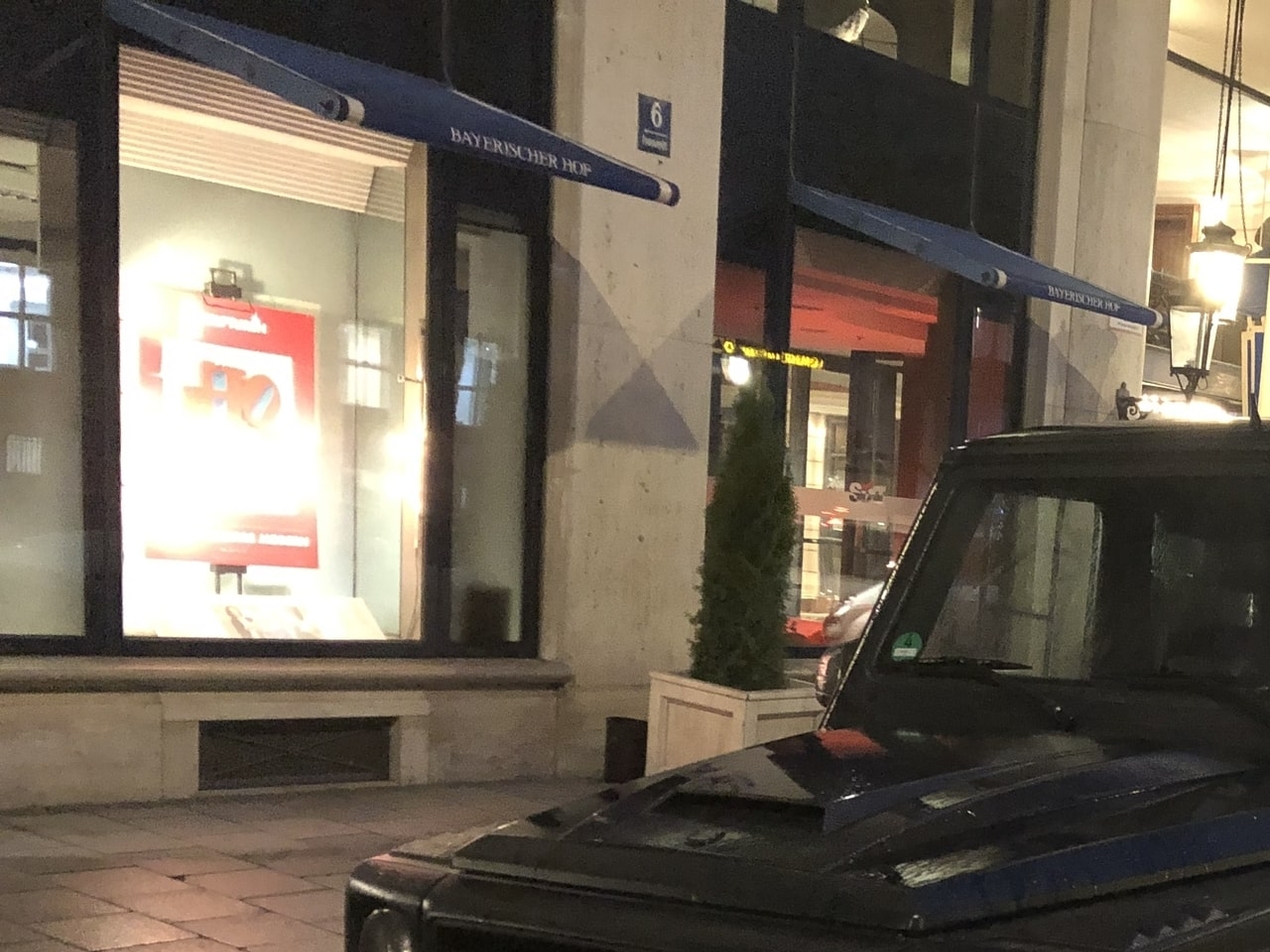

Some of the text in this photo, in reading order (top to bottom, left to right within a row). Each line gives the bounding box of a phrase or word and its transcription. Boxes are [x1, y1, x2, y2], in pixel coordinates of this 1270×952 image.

[650, 101, 663, 128] 6
[450, 127, 593, 177] BAYERISCHER HOF
[1048, 285, 1121, 312] BAYERISCHER HOF
